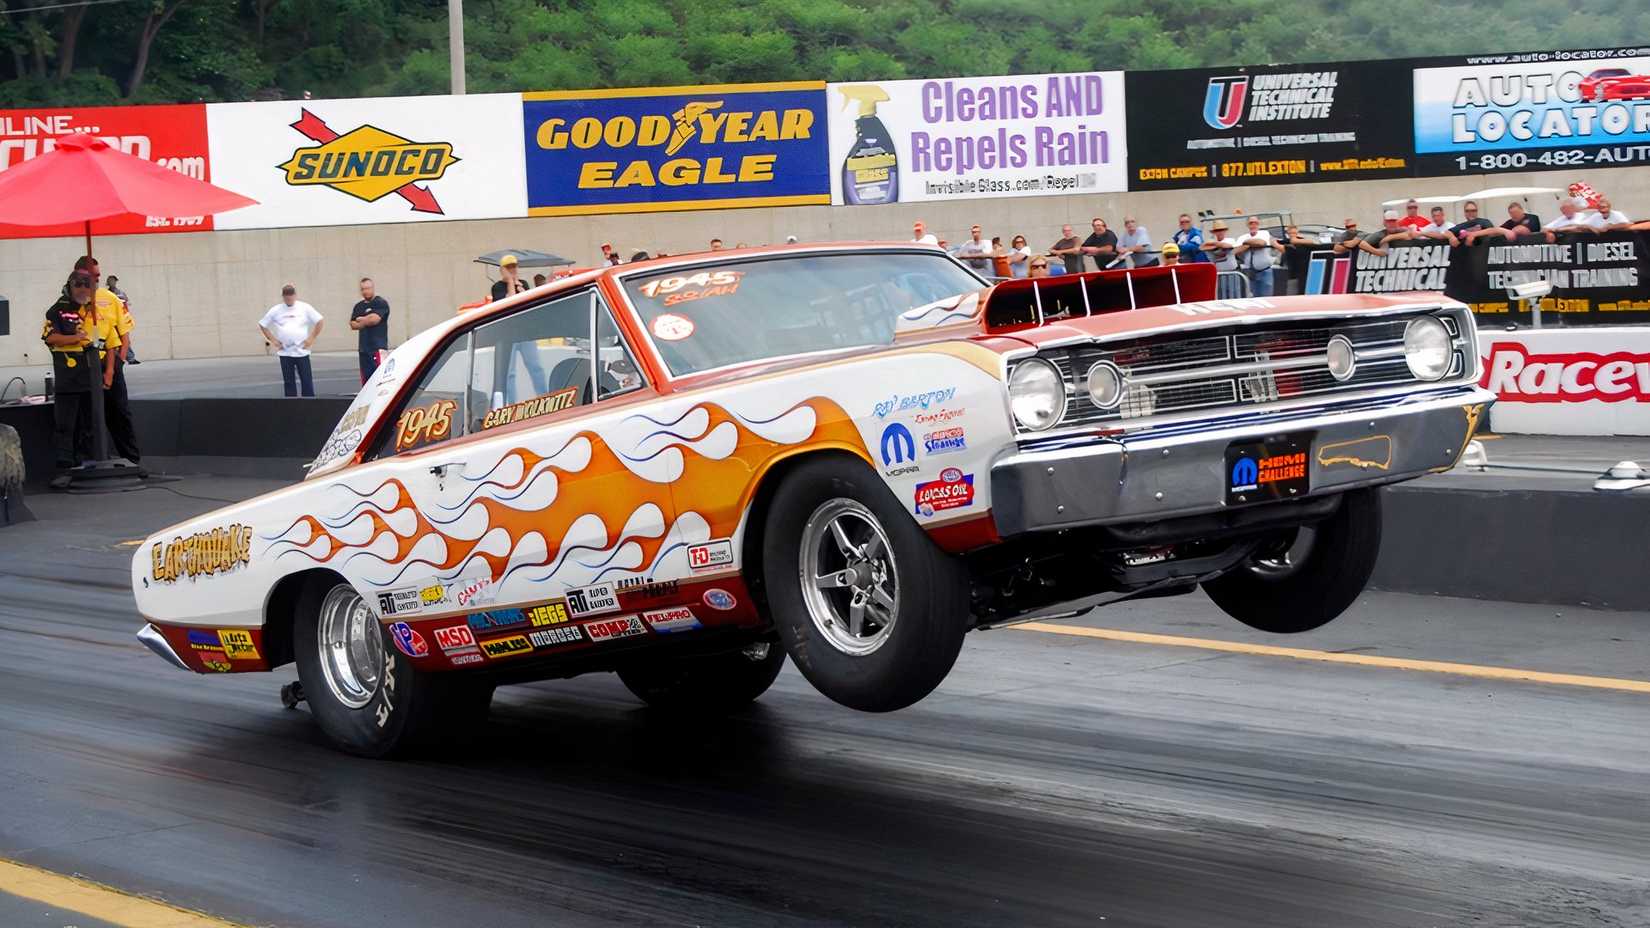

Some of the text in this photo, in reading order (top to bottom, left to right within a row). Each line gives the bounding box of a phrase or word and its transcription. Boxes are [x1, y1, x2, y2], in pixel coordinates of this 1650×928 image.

[1253, 72, 1338, 90] UNIVERSAL
[1453, 71, 1586, 108] AUTO
[922, 75, 1104, 123] Cleans AND
[1251, 87, 1334, 105] TECHNICAL
[1248, 103, 1332, 121] INSTITUTE
[911, 125, 1109, 175] Repels Rain
[1456, 147, 1650, 170] 1-800-482-AUT
[293, 148, 447, 180] SUNOCO
[577, 154, 777, 189] EAGLE
[1356, 245, 1451, 269] UNIVERSAL
[1488, 241, 1638, 264] AUTOMOTIVE DIESEL
[638, 271, 747, 298] 1945
[1355, 268, 1448, 292] TECHNICAL
[1571, 267, 1638, 288] TRAINING
[396, 400, 457, 453] 1945
[1258, 465, 1305, 484] CHALLENGE
[918, 485, 951, 503] LUCAS
[952, 483, 968, 497] OIL
[528, 603, 569, 627] JEGS
[437, 626, 472, 648] MSD
